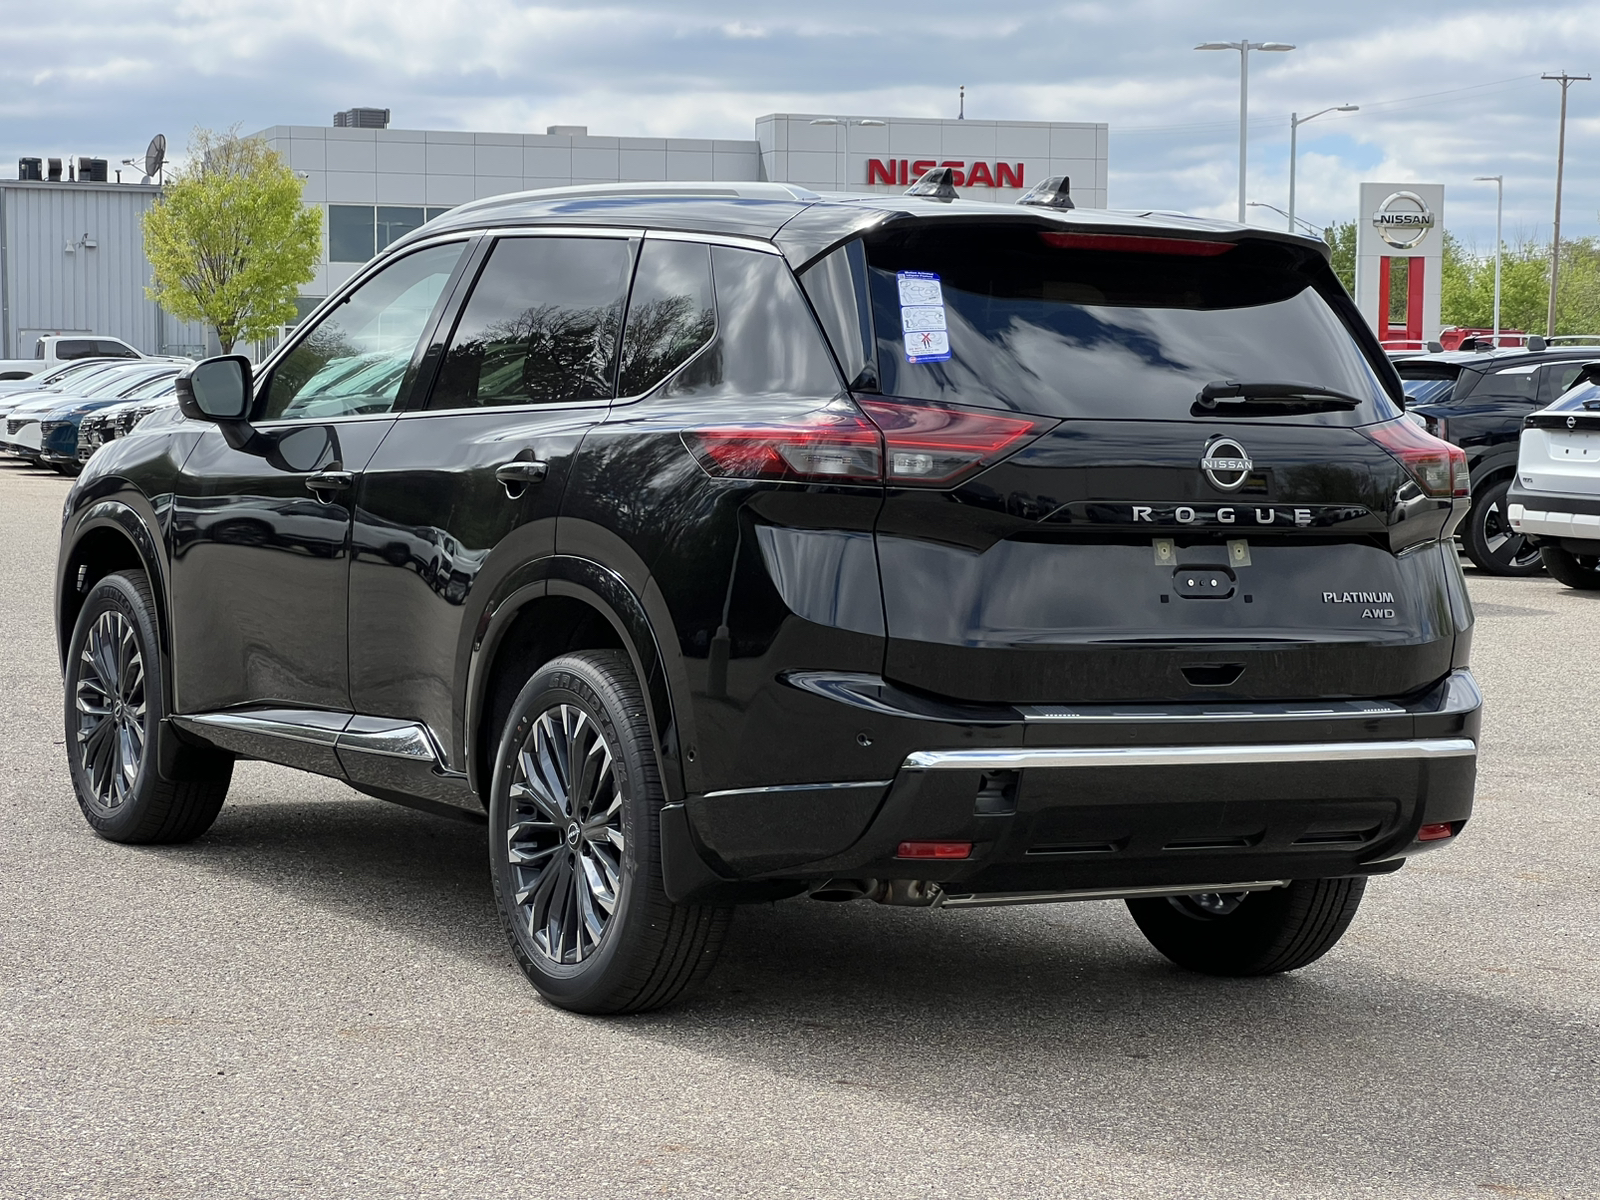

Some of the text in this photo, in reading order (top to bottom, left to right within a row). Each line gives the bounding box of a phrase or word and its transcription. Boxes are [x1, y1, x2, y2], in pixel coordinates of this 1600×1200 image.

[868, 158, 1025, 188] NISSAN
[1380, 214, 1430, 224] NISSAN
[1203, 458, 1253, 470] NISSAN
[1132, 506, 1312, 525] ROGUE
[1322, 591, 1395, 603] PLATINUM
[1361, 608, 1396, 619] AWD
[547, 672, 629, 783] GRANDTREK
